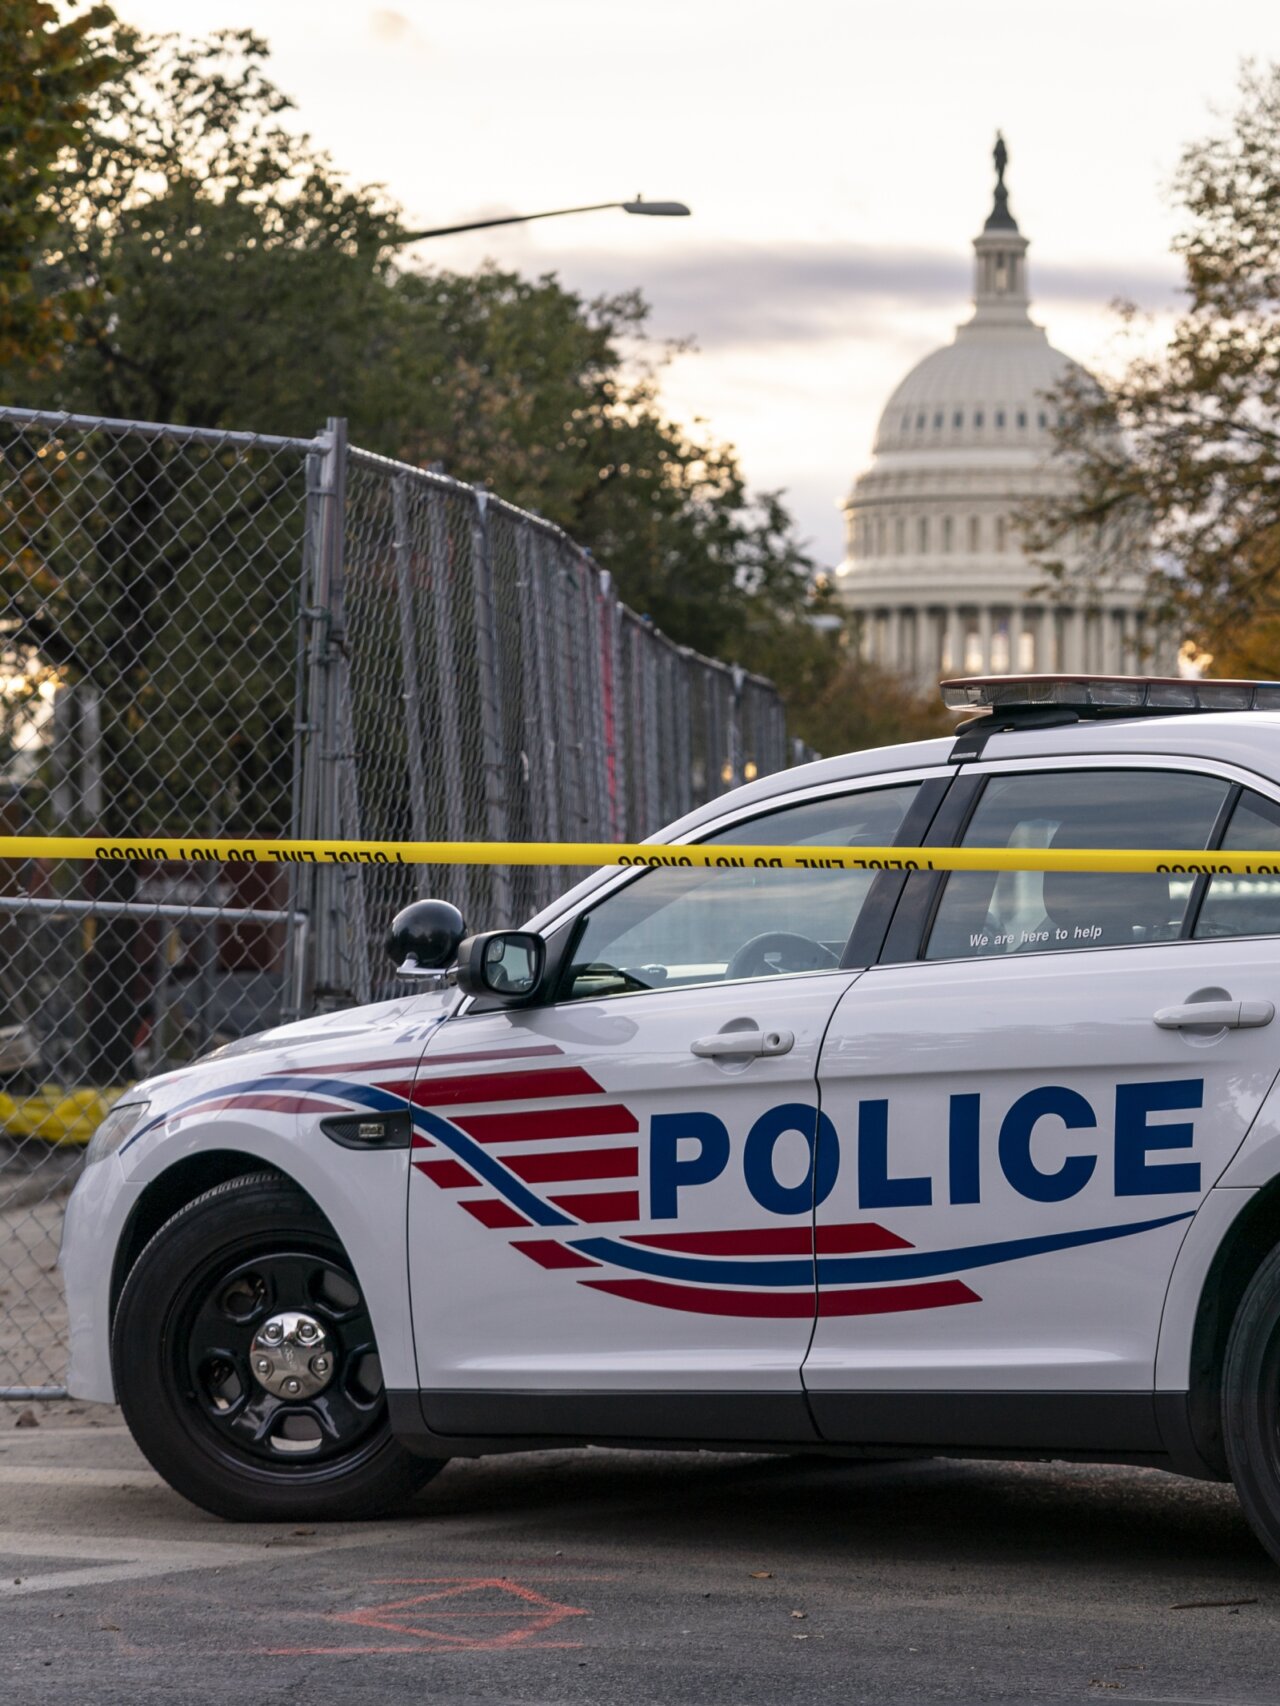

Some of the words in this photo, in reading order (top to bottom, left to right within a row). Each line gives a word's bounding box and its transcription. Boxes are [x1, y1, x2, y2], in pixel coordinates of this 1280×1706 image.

[970, 934, 988, 946] We
[994, 934, 1015, 945] are
[1020, 930, 1050, 943] here
[1055, 927, 1068, 940] to
[1073, 925, 1102, 940] help
[650, 1078, 1204, 1220] POLICE
